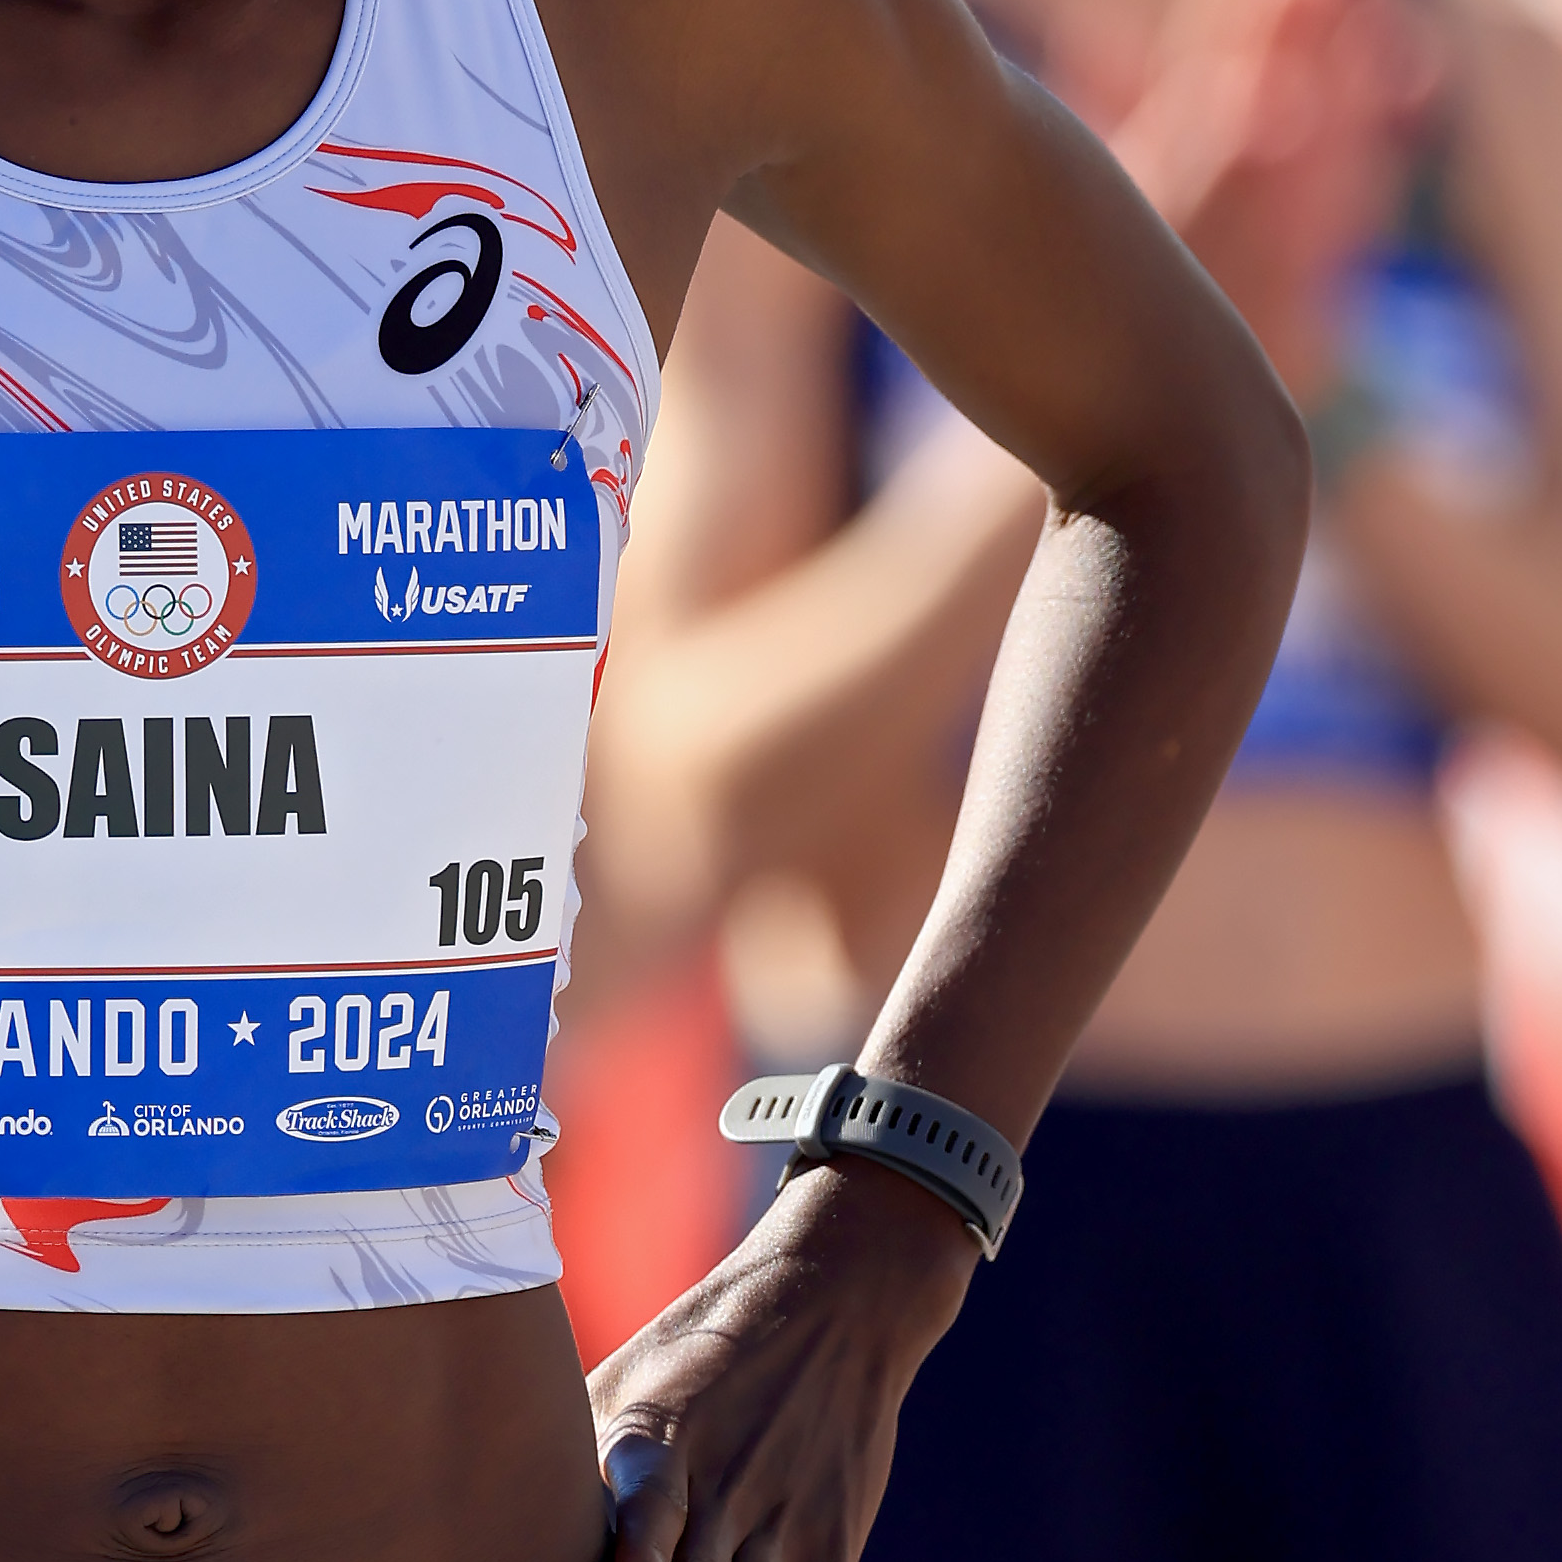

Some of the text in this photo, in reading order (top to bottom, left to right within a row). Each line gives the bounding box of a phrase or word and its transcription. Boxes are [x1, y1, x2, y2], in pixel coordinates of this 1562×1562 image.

[82, 479, 233, 532] UNITED STATES
[338, 498, 566, 555] MARATHON
[421, 584, 529, 615] USATF
[85, 624, 233, 674] OLYMPIC TEAM
[429, 856, 545, 947] 105
[288, 990, 450, 1073] 2024
[133, 1104, 191, 1117] CITY OF
[459, 1096, 536, 1120] ORLANDO
[460, 1084, 538, 1103] GREATER
[133, 1117, 245, 1136] ORLANDO
